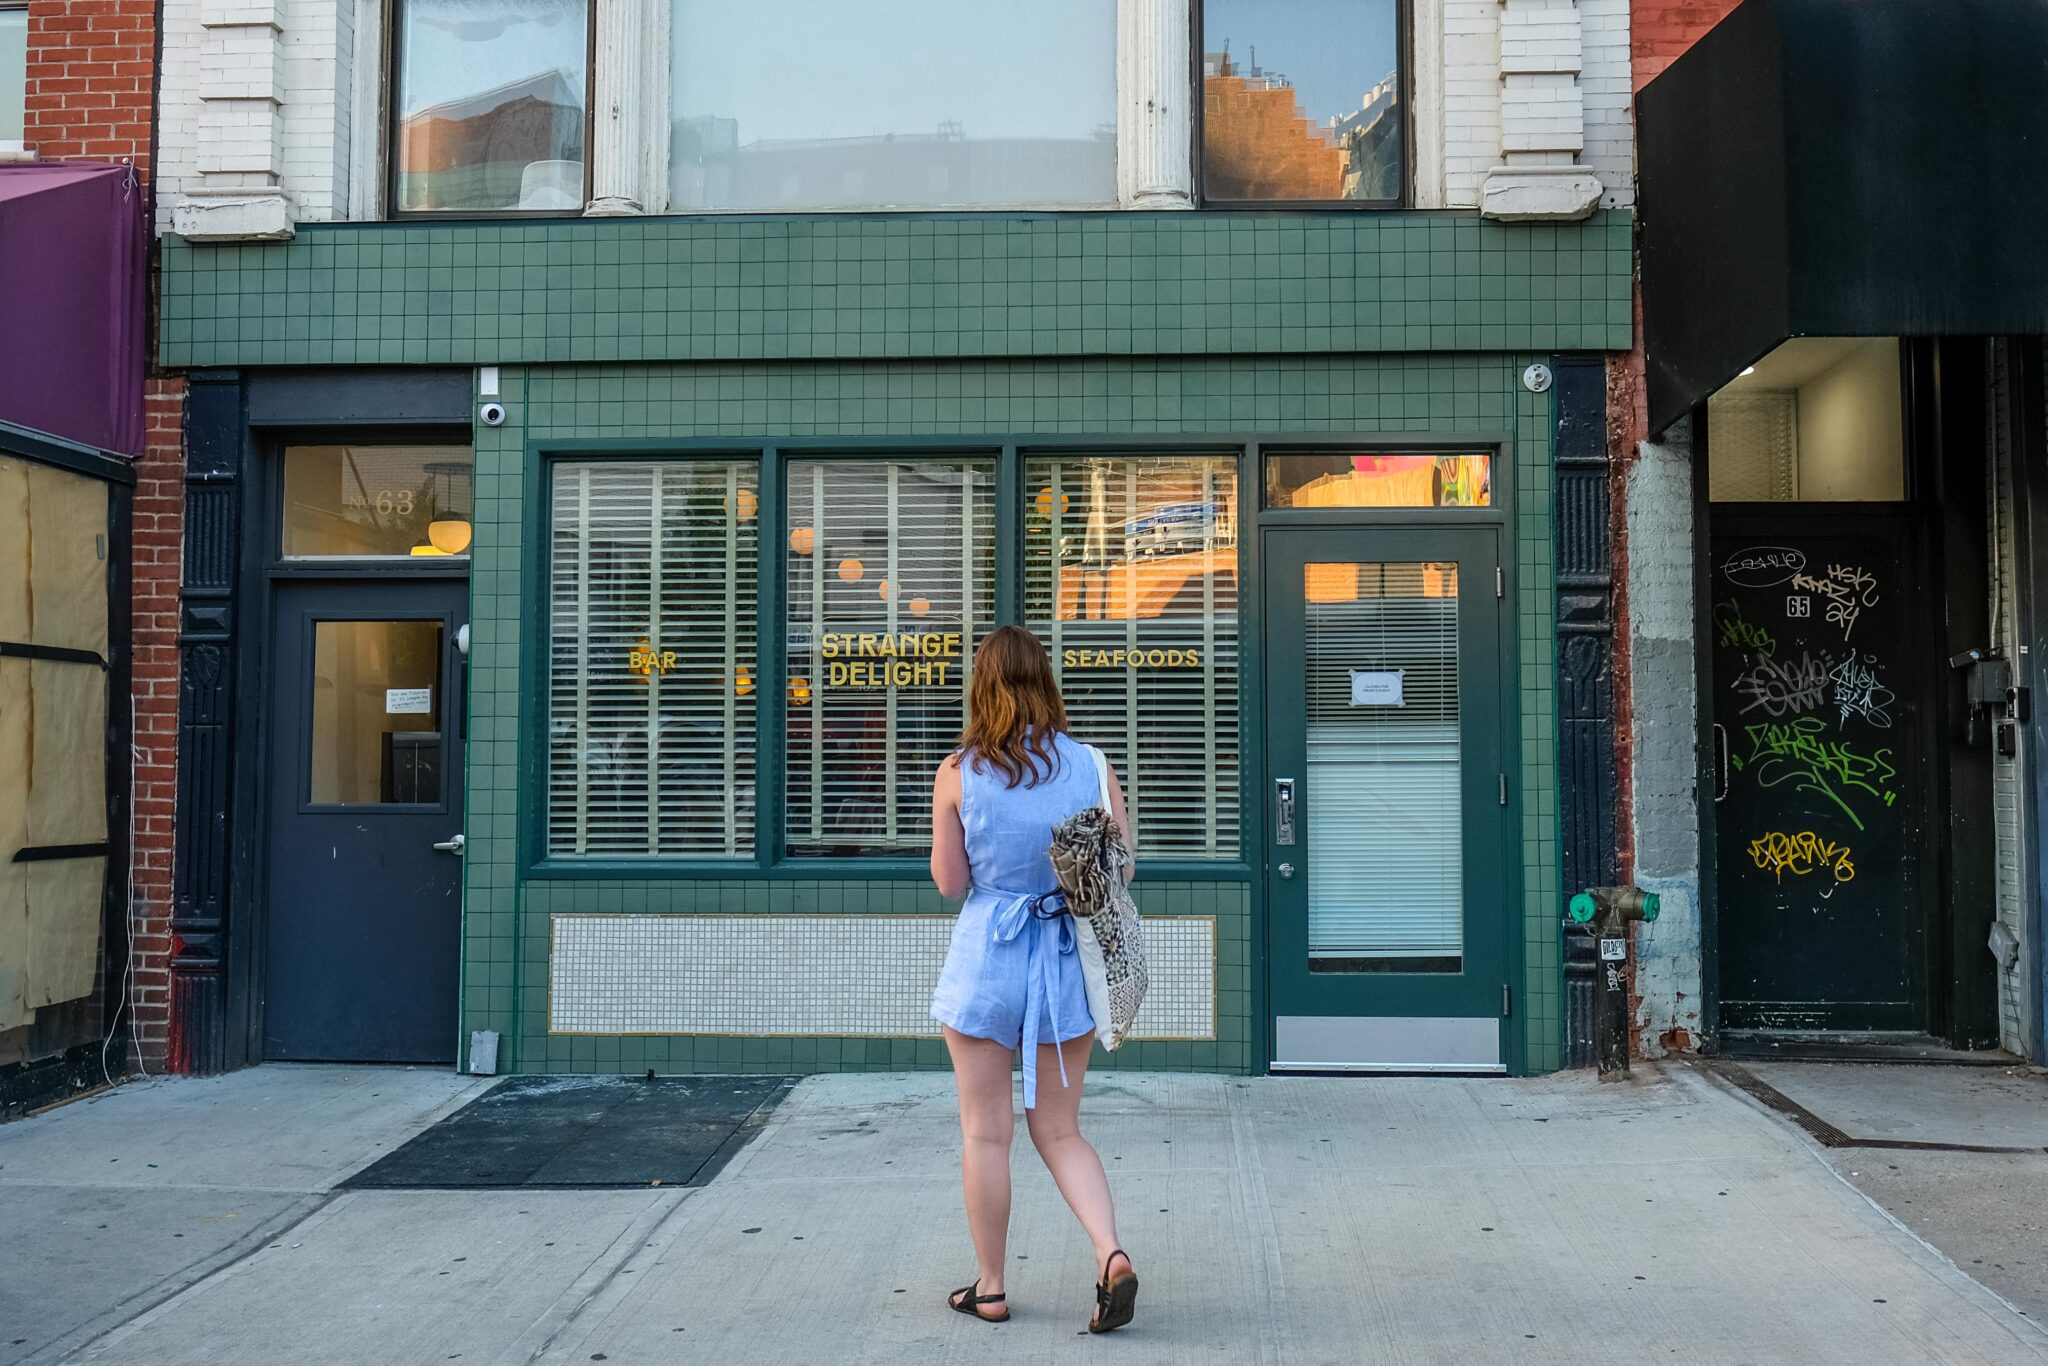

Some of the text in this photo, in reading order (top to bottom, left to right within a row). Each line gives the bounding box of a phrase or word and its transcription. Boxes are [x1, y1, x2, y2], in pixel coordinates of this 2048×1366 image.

[376, 489, 414, 515] 63
[1788, 597, 1809, 616] 65
[821, 633, 960, 658] STRANGE
[630, 651, 677, 669] BAR
[1064, 649, 1199, 668] SEAFOODS
[829, 661, 951, 686] DELIGHT
